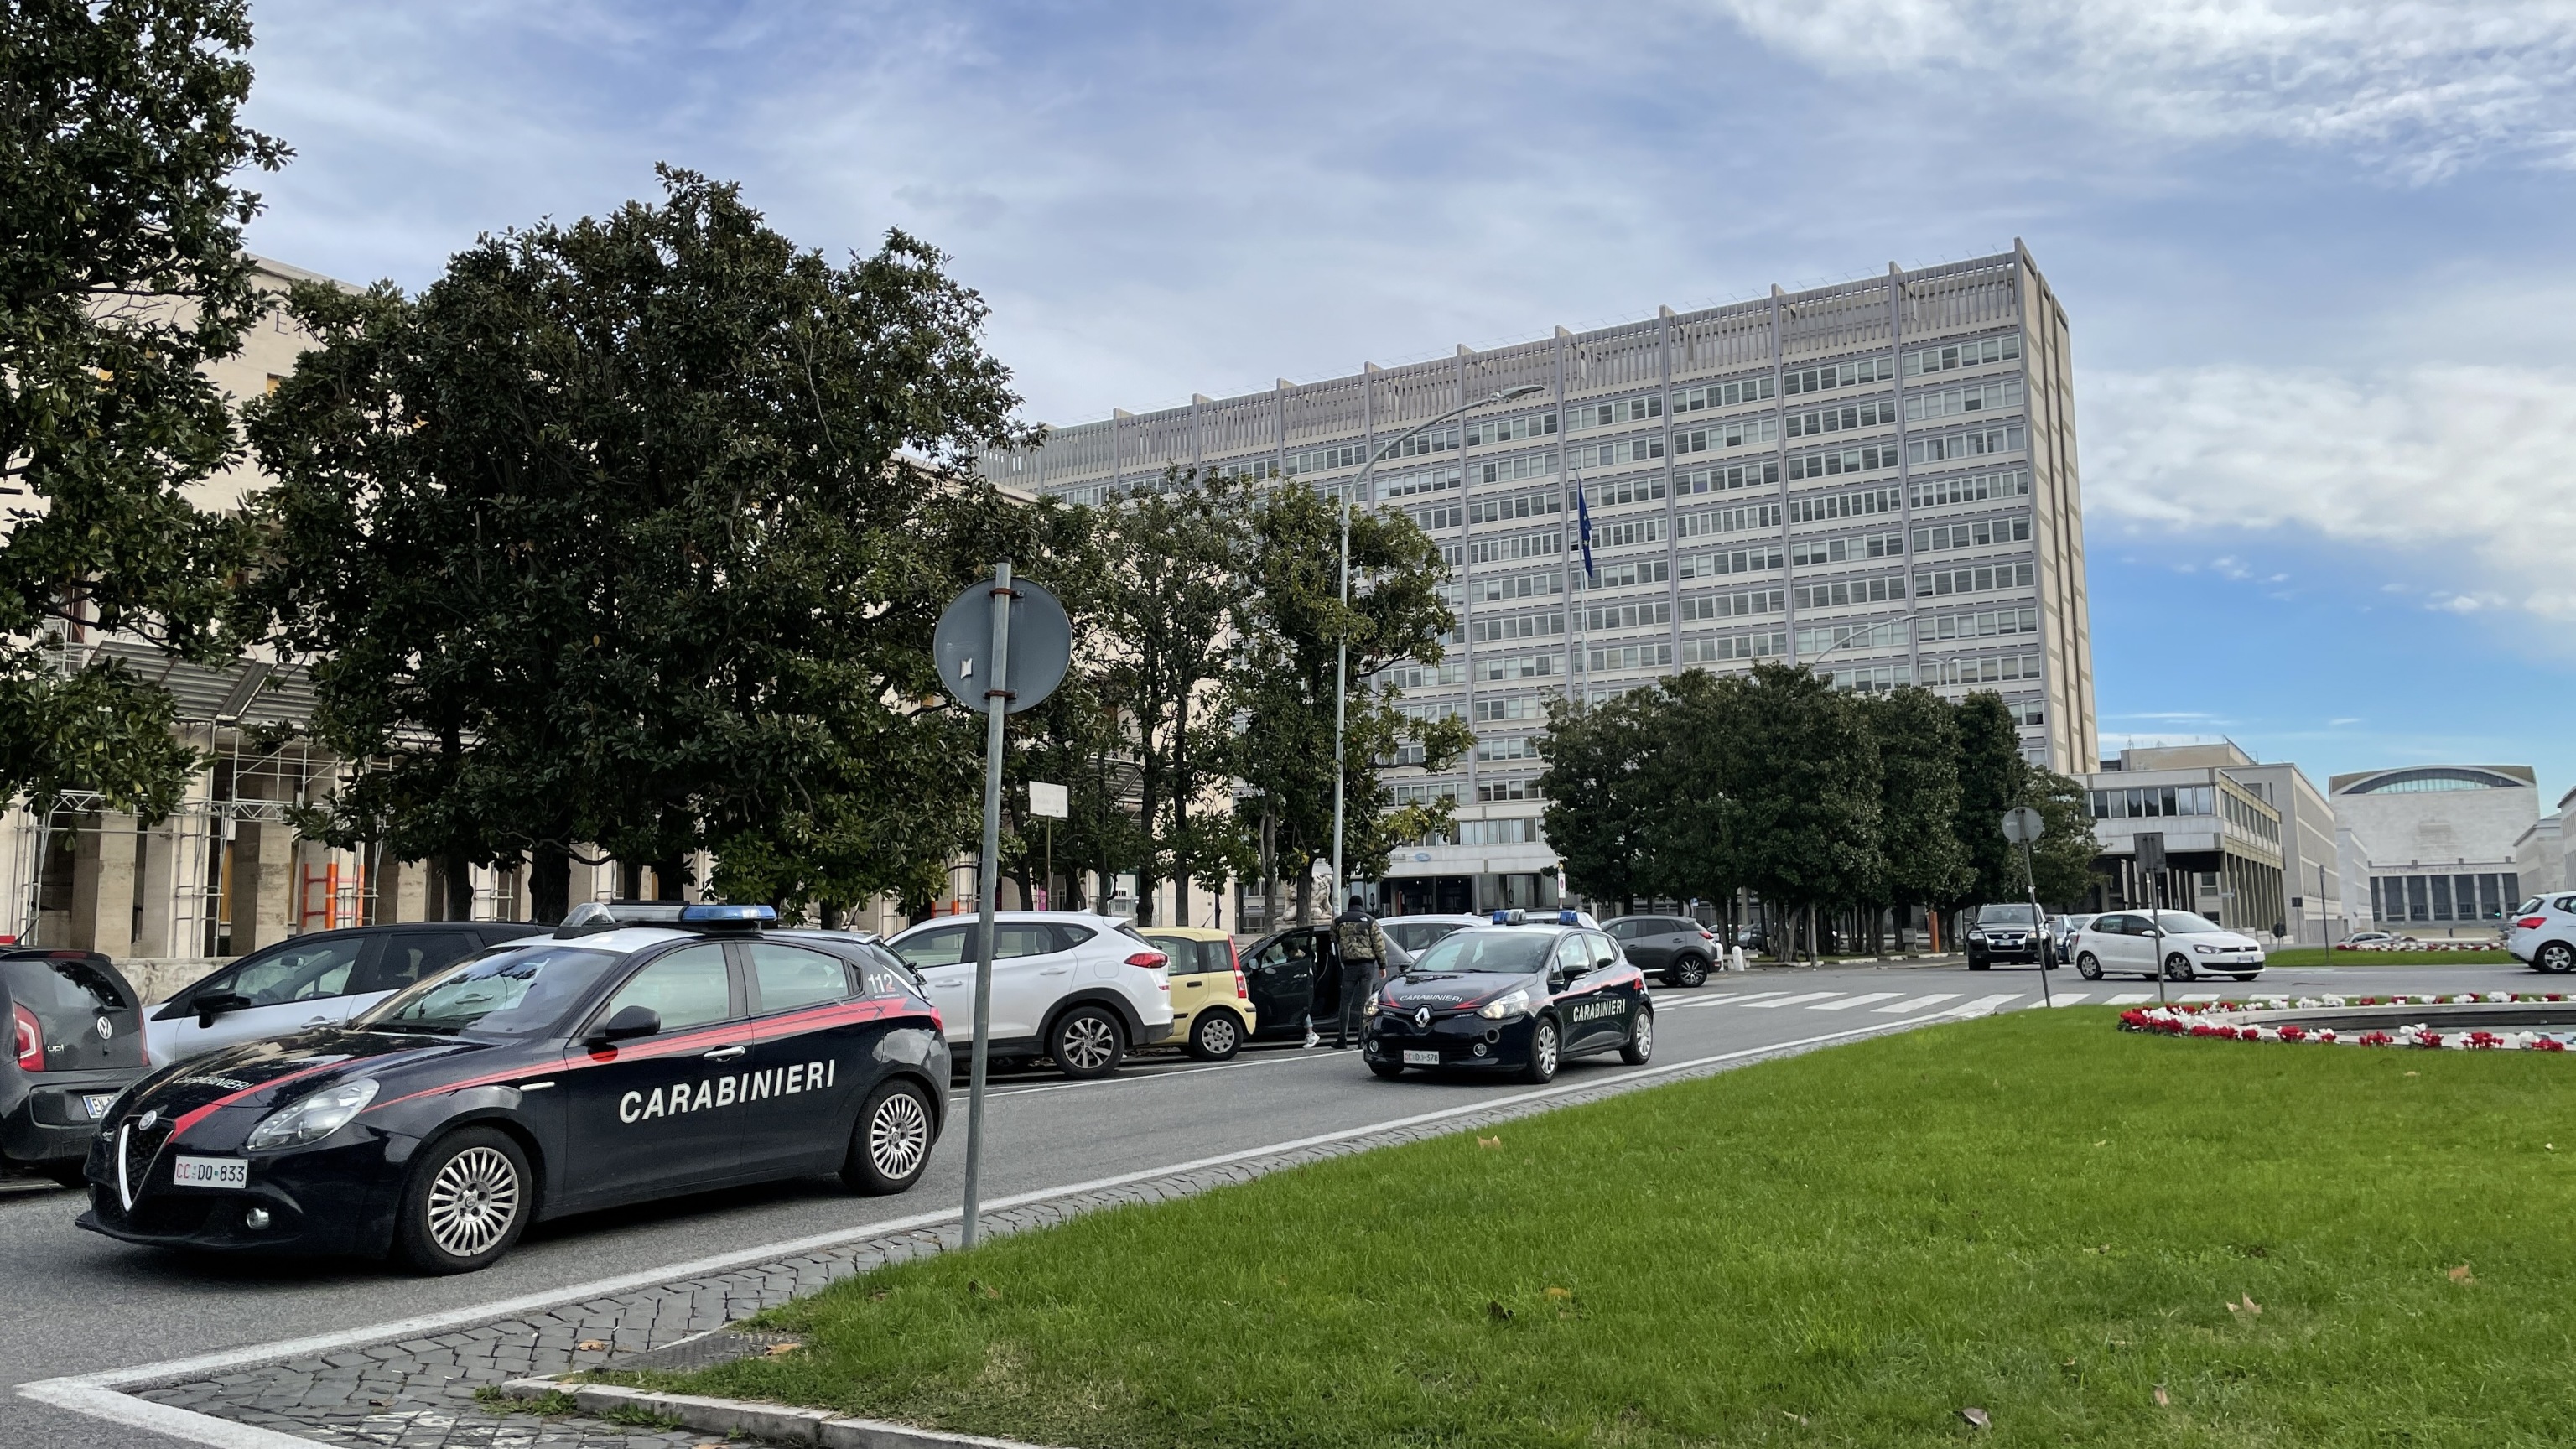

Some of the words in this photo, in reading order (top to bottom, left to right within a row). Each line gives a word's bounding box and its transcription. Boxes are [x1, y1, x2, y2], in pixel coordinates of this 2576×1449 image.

[867, 973, 896, 994] 112
[1399, 994, 1463, 1003] CARABINIERI
[1573, 998, 1626, 1023] CARABINIERI
[619, 1059, 835, 1124] CARABINIERI
